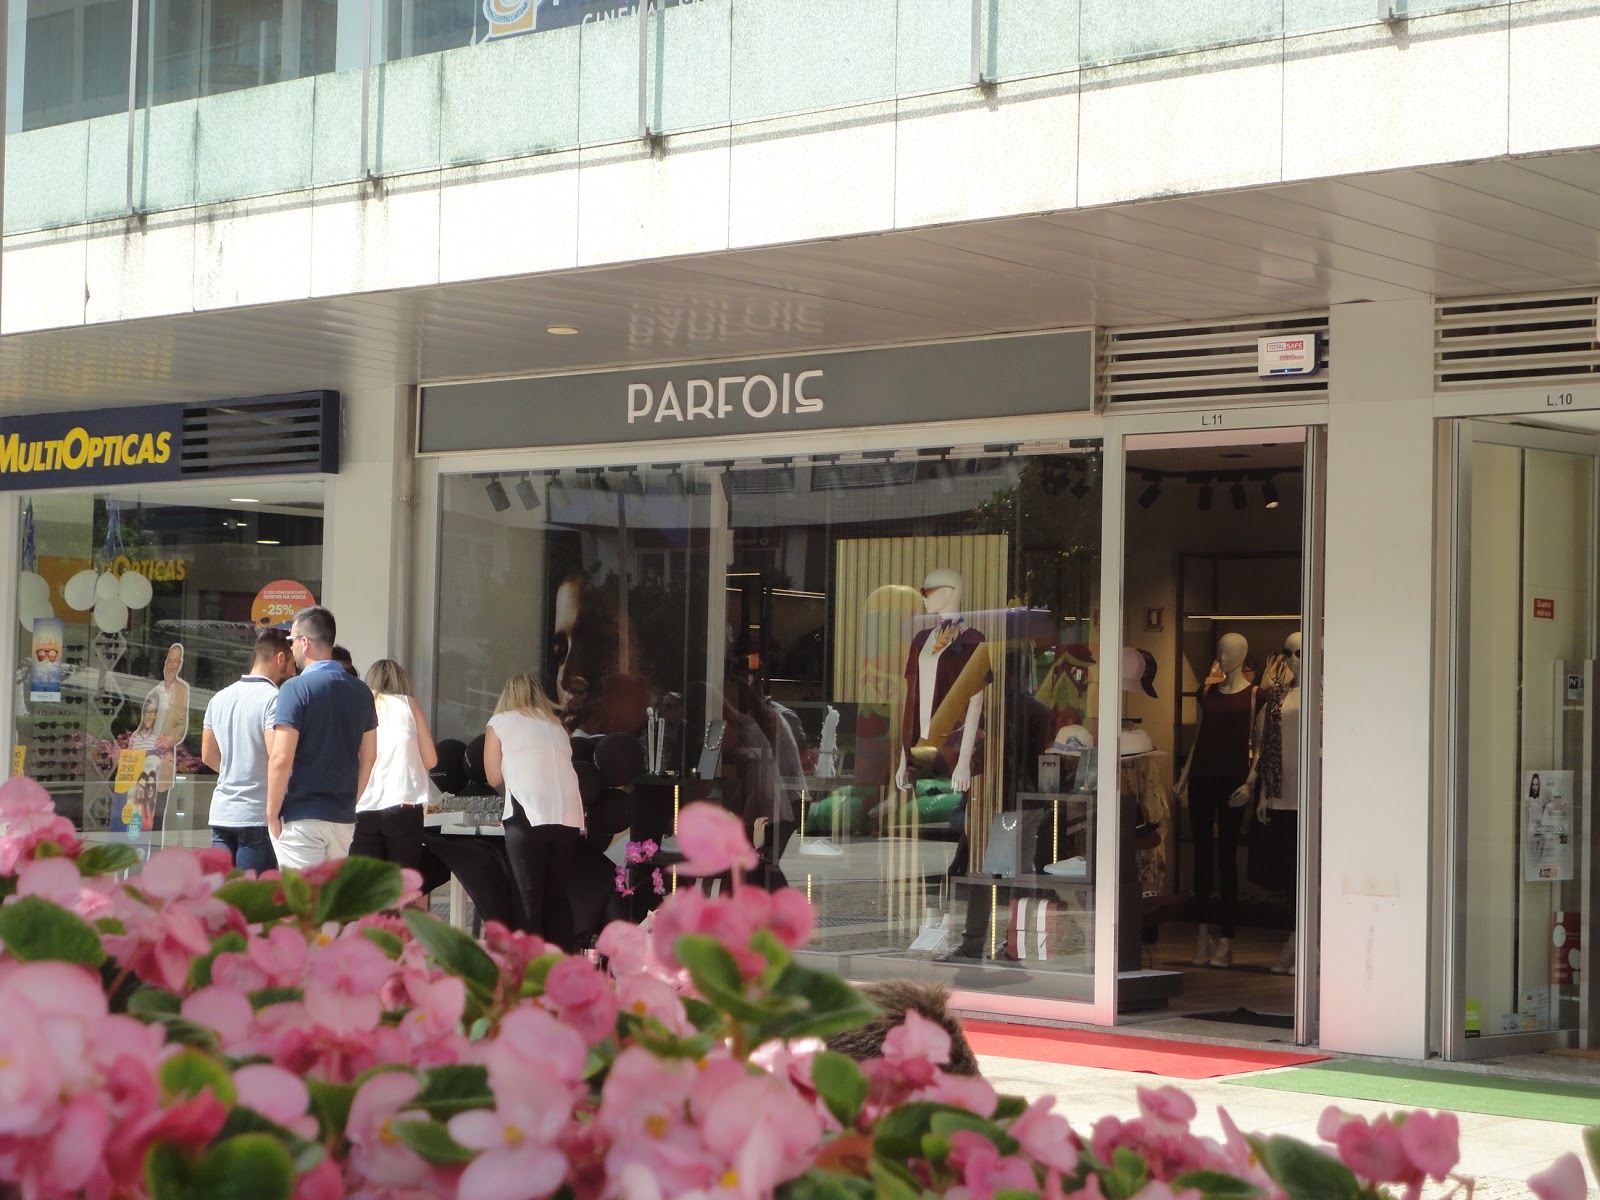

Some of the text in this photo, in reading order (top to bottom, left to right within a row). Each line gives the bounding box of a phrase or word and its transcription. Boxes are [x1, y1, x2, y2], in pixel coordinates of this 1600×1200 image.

[1268, 341, 1303, 351] TOTAL SAFE
[627, 369, 824, 423] PARFOIS
[1546, 393, 1573, 406] L.10
[1202, 414, 1222, 426] L.11
